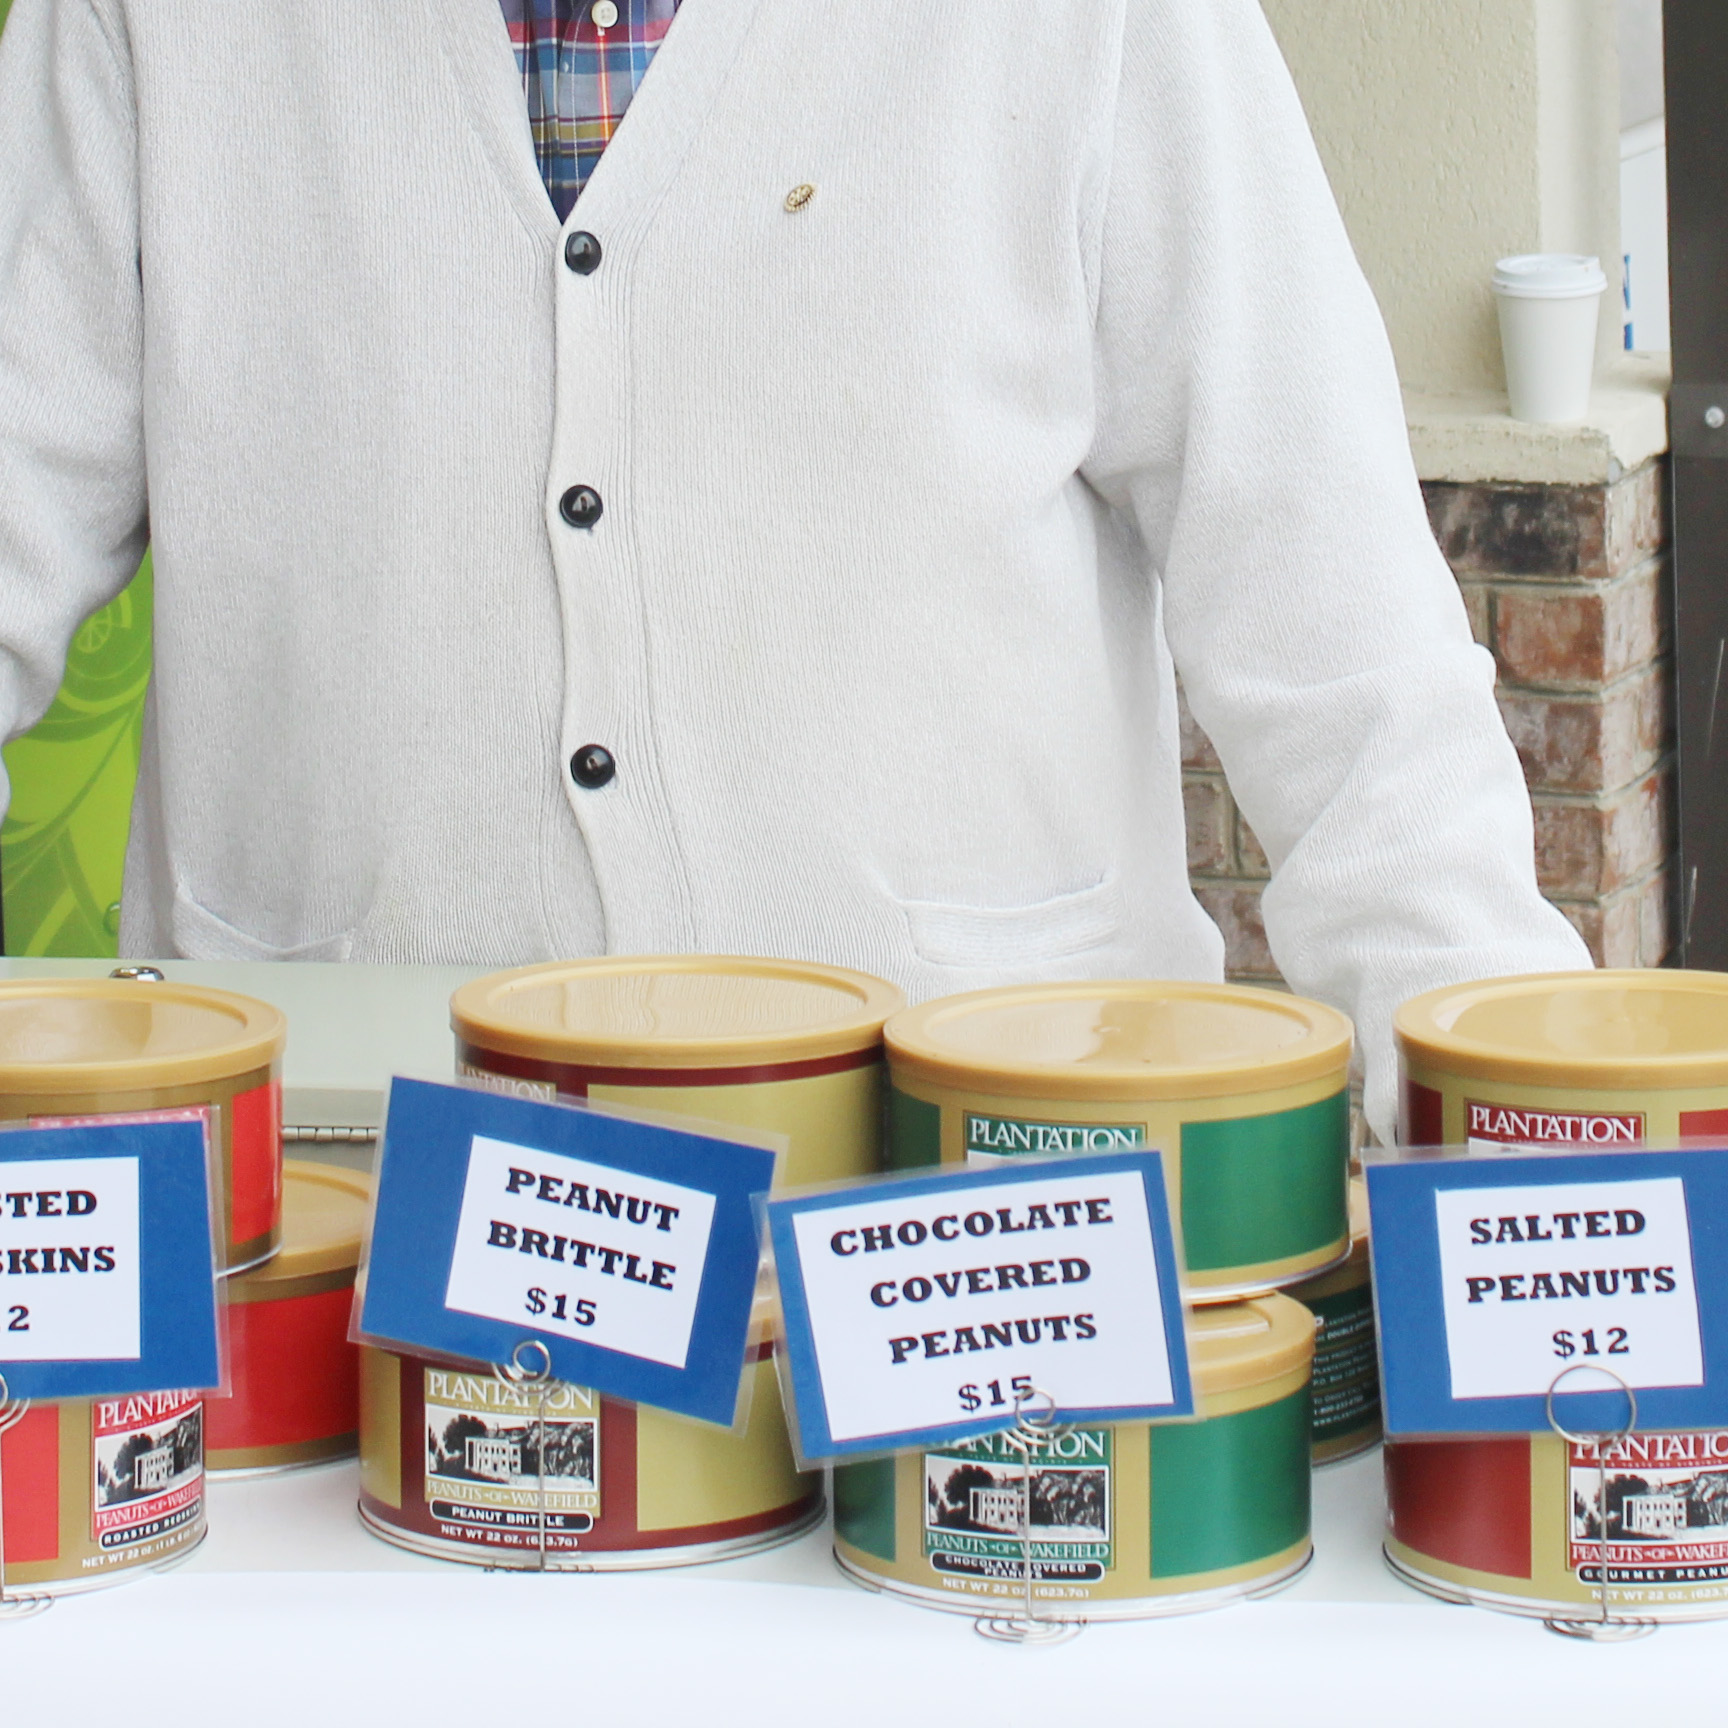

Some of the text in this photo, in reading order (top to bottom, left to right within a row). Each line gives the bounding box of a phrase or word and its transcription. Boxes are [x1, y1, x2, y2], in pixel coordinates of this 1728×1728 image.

[971, 1117, 1137, 1153] PLANTATION
[1471, 1104, 1637, 1143] PLANTATION
[505, 1167, 679, 1232] PEANUT
[830, 1197, 1114, 1257] CHOCOLATE
[1470, 1209, 1646, 1245] SALTED
[487, 1221, 676, 1291] BRITTLE
[870, 1257, 1092, 1309] COVERED
[1466, 1266, 1677, 1304] PEANUTS
[524, 1286, 597, 1327] $15
[889, 1313, 1097, 1365] PEANUTS
[1552, 1327, 1630, 1359] $12
[429, 1371, 593, 1411] PLANTATION
[957, 1374, 1035, 1413] $15
[427, 1478, 484, 1501] PEANUTS
[96, 1503, 150, 1529] PEANUTS
[452, 1505, 565, 1528] PEANUT BRITLE
[104, 1522, 160, 1546] ROASTED
[441, 1523, 462, 1537] NET
[465, 1528, 483, 1540] WT
[486, 1530, 502, 1543] 22
[926, 1531, 988, 1554] PEANUTS
[81, 1555, 106, 1569] NET
[108, 1551, 125, 1565] WT
[944, 1555, 1087, 1574] CHOCOLATE OVERED
[1572, 1544, 1644, 1562] PEANUTS
[942, 1577, 966, 1591] NET
[970, 1581, 989, 1593] WT
[992, 1584, 1009, 1596] 22
[1583, 1569, 1666, 1581] GOURMET
[1621, 1590, 1644, 1602] WT
[1647, 1590, 1665, 1602] 22
